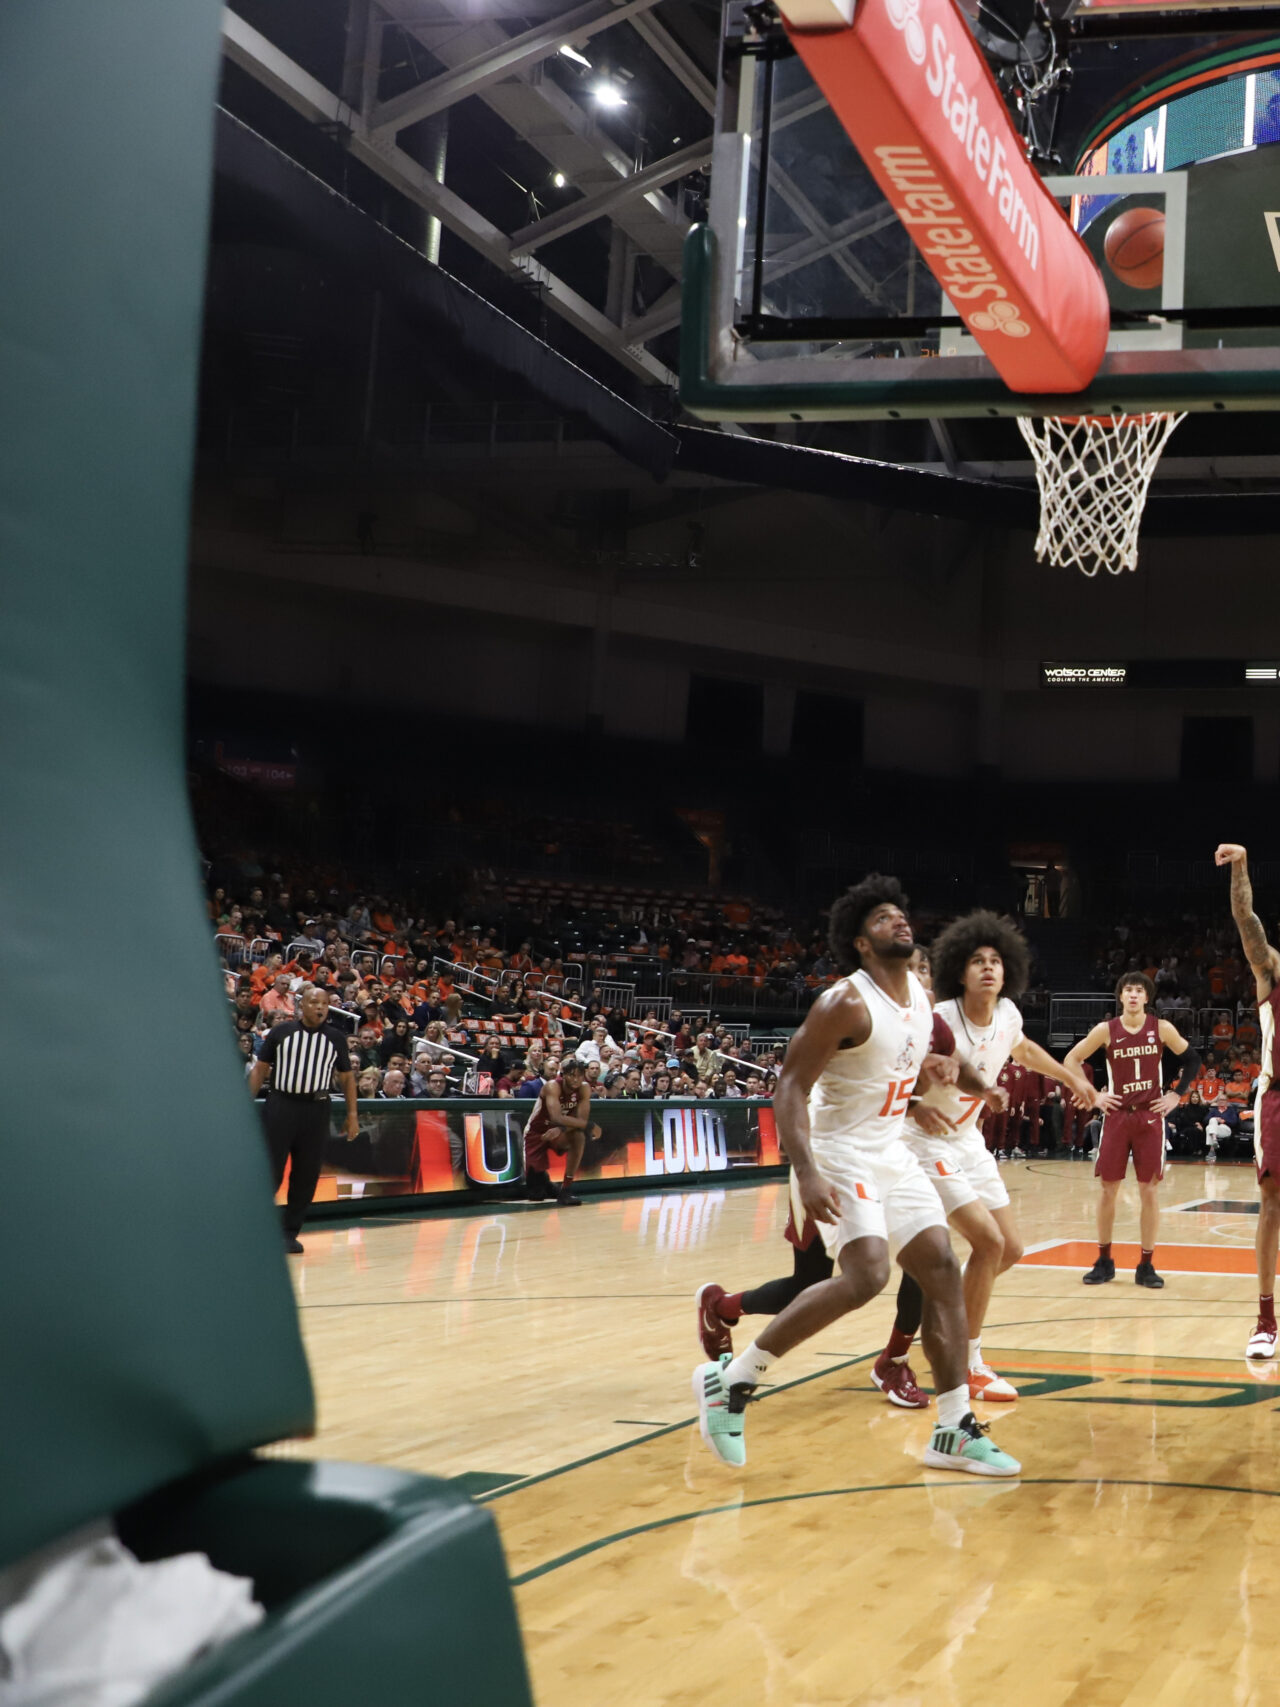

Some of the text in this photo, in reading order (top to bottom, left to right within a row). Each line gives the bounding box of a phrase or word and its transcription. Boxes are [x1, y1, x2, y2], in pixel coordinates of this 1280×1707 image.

[1113, 1045, 1158, 1060] FLORIDA
[1133, 1059, 1140, 1080] 1
[878, 1077, 915, 1117] 15
[1122, 1080, 1153, 1095] STATE
[953, 1096, 982, 1125] 7
